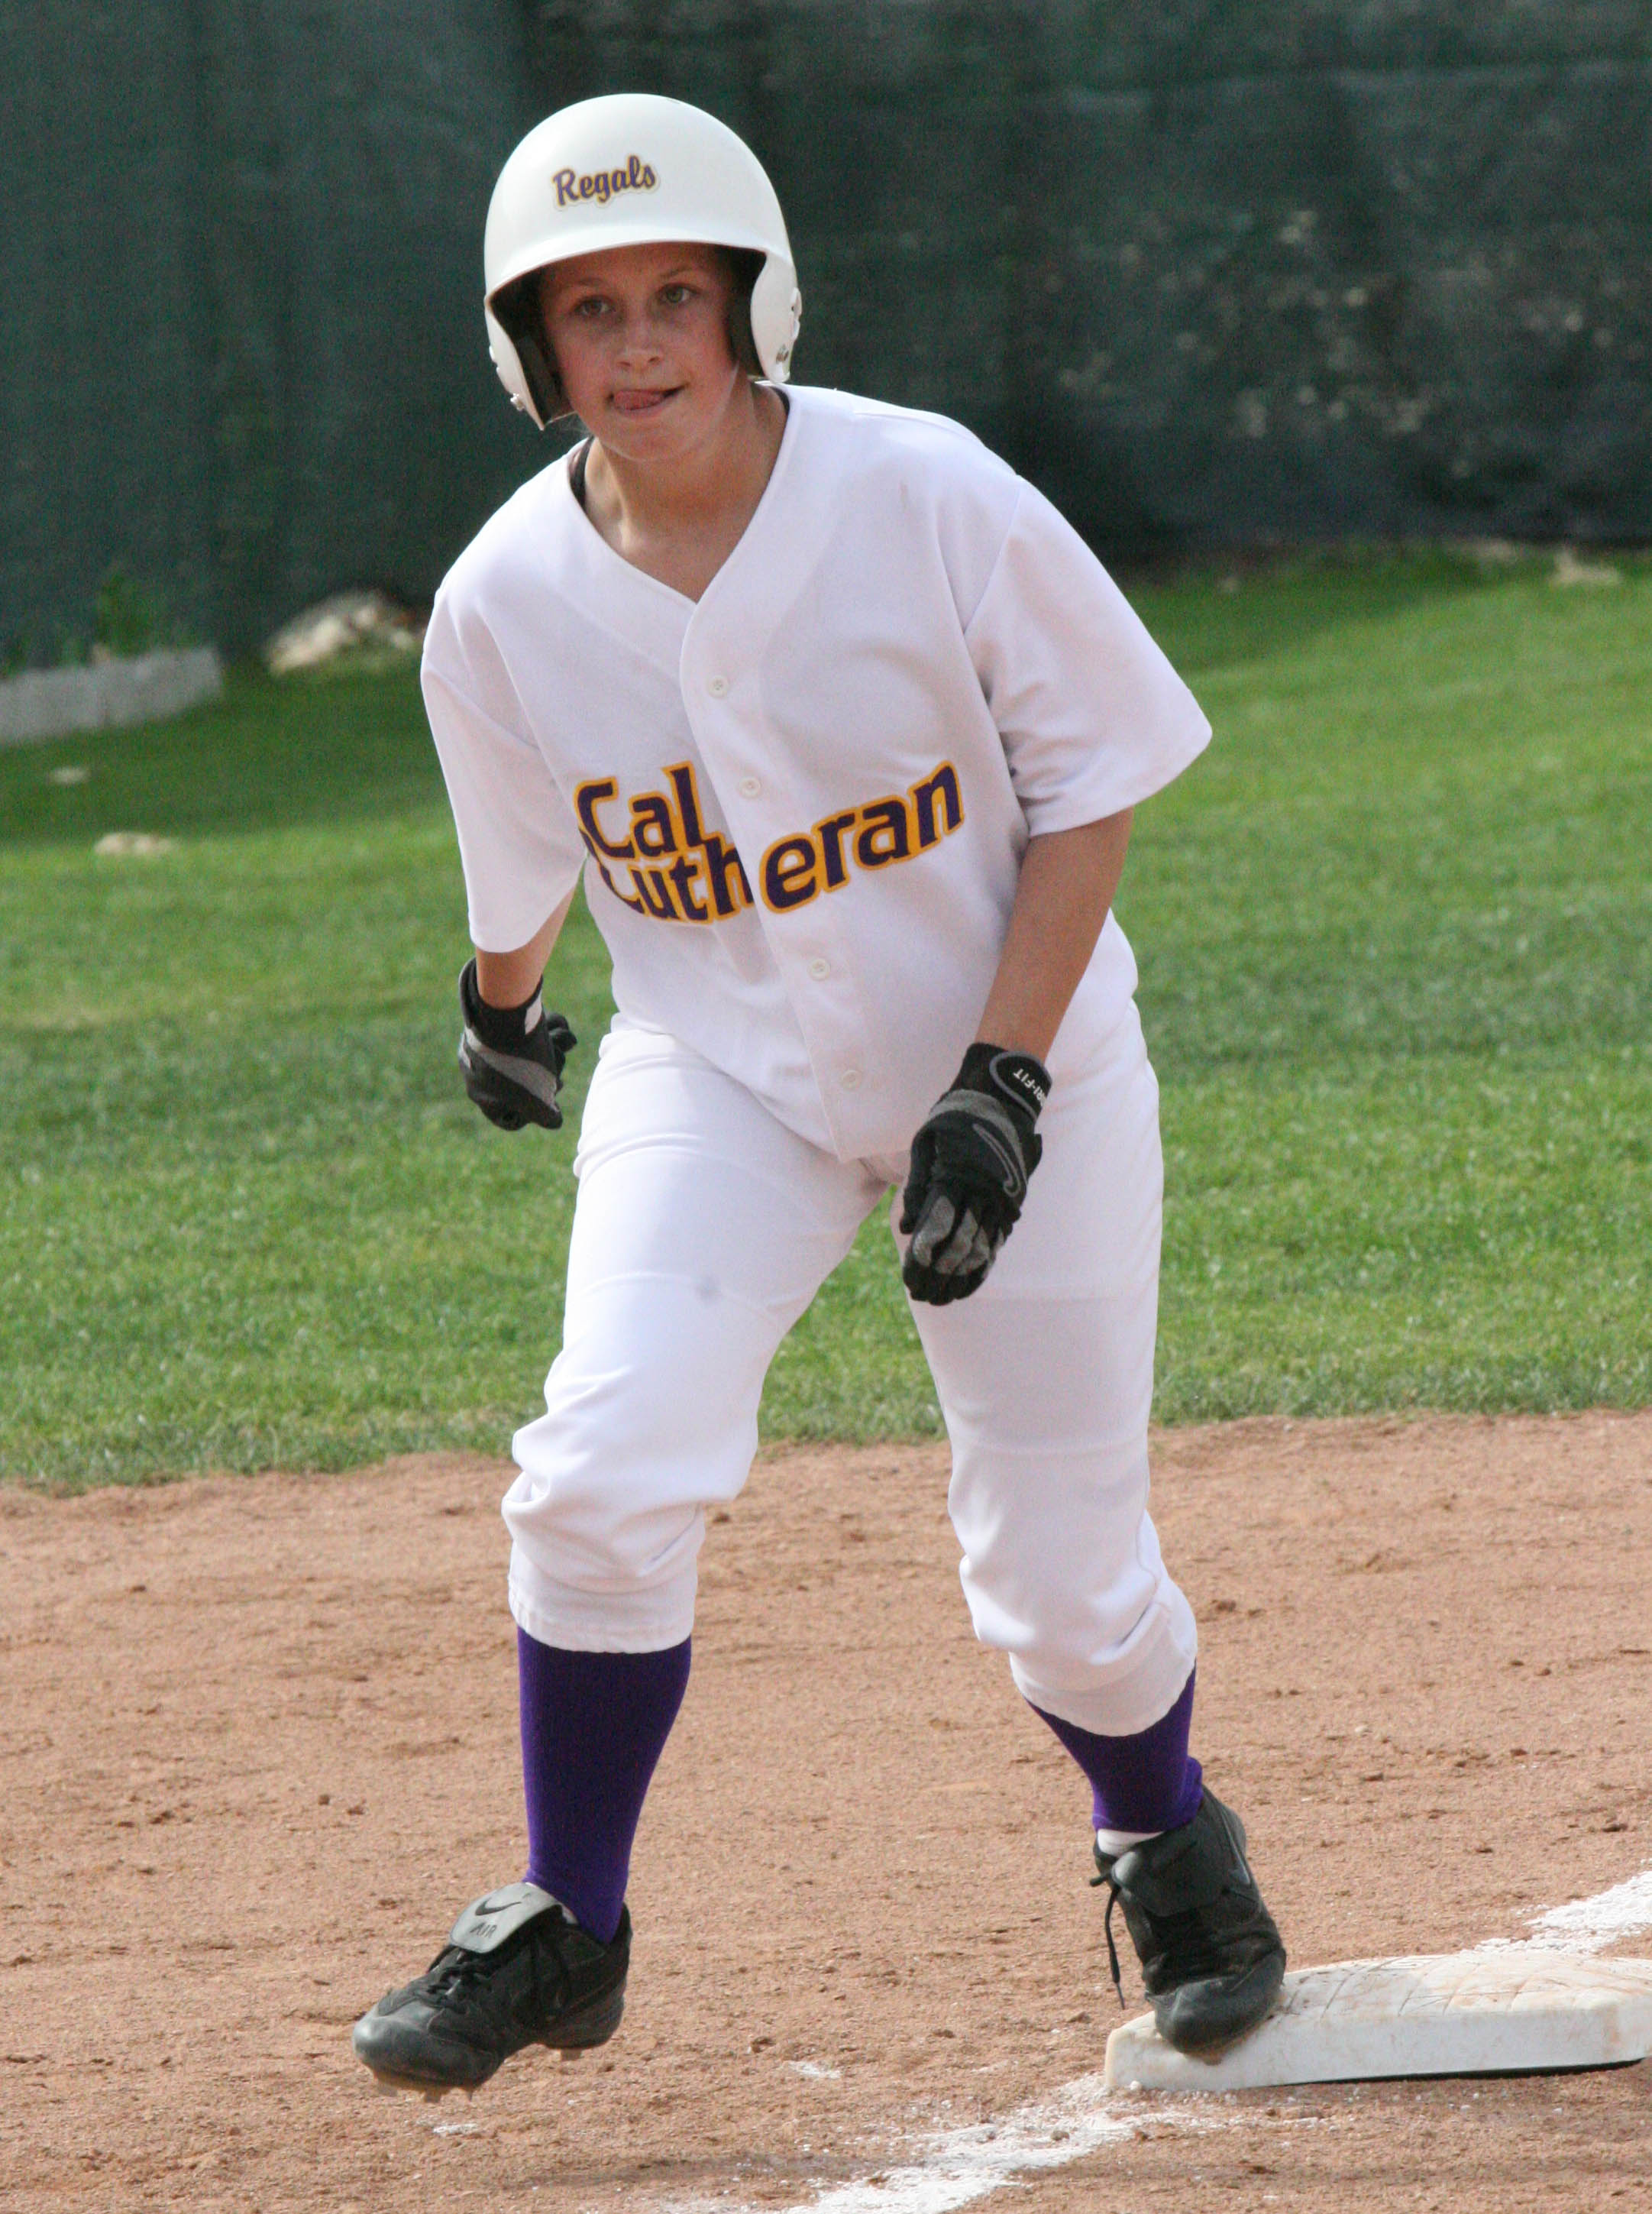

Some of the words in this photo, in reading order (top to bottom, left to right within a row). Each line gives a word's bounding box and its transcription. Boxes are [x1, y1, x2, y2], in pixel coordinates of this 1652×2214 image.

[551, 154, 658, 208] Regals
[574, 760, 703, 862] Cal
[470, 1921, 497, 1939] AIR
